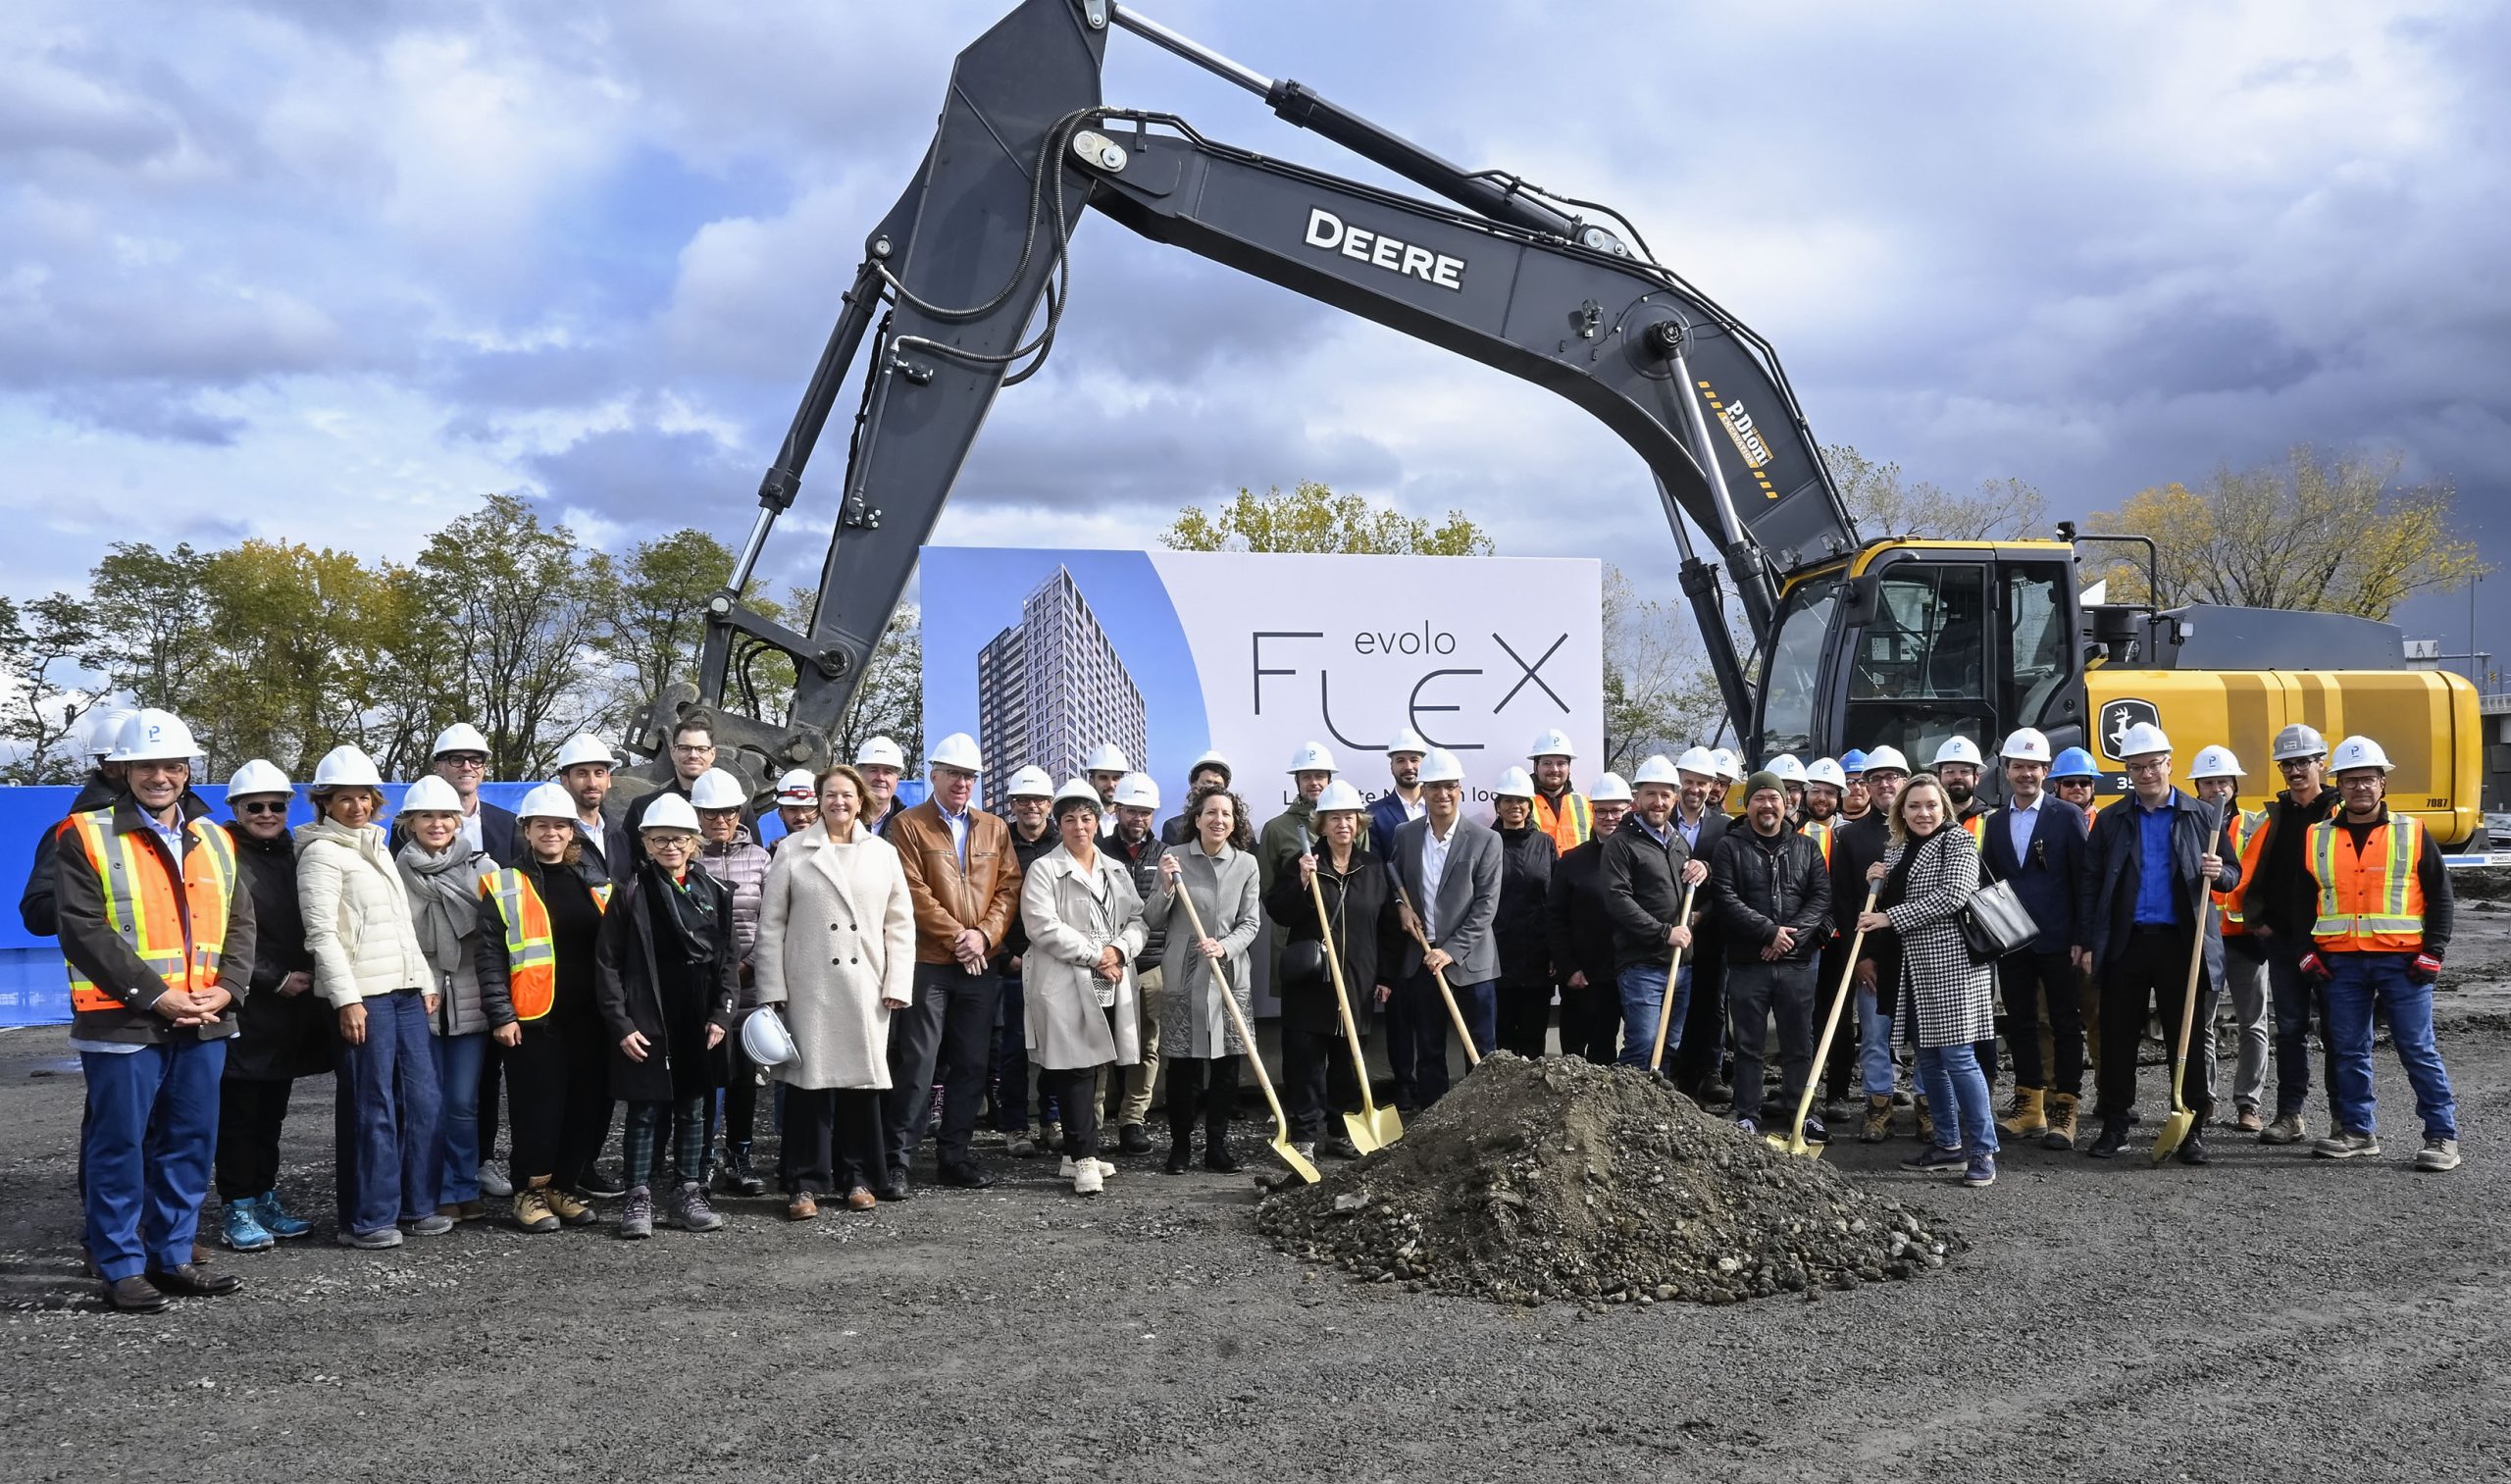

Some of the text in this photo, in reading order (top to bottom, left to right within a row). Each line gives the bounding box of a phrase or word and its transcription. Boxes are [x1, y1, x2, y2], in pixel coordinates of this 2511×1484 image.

[1306, 208, 1464, 290] DEERE
[1721, 414, 1756, 465] EXCAVATION
[1355, 619, 1457, 654] evolo
[1253, 632, 1570, 751] FLEX
[2426, 798, 2448, 807] 7087
